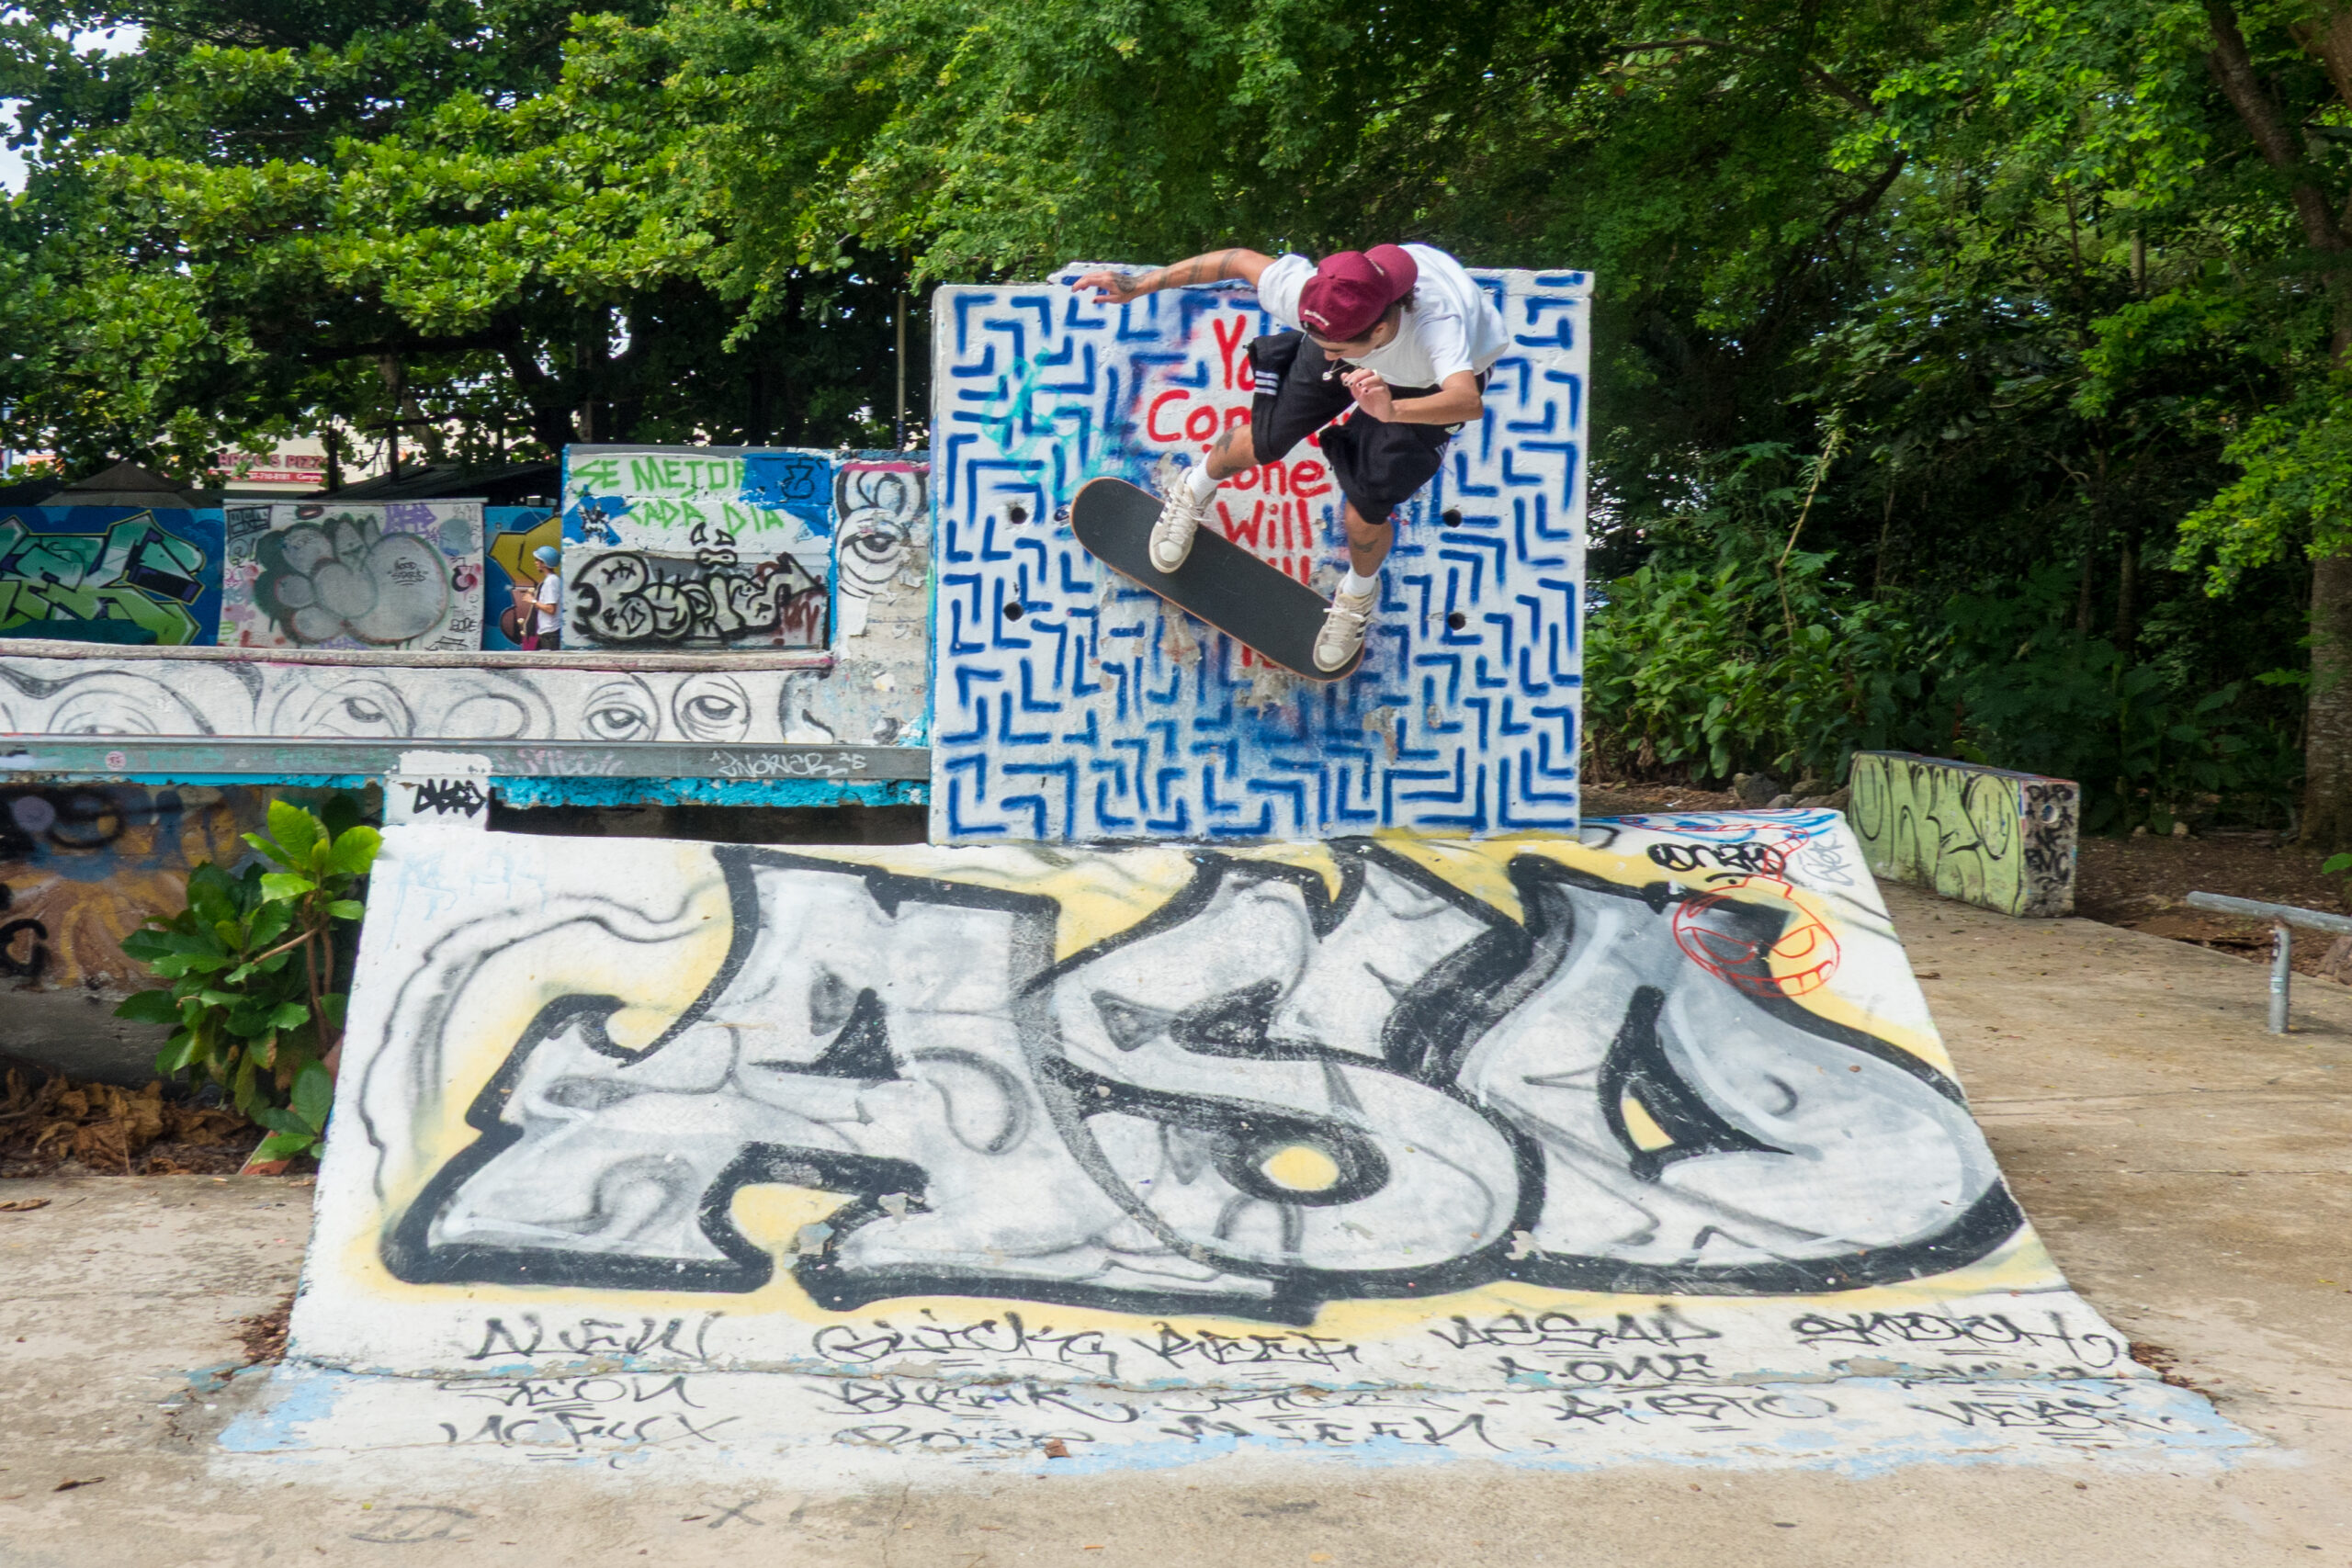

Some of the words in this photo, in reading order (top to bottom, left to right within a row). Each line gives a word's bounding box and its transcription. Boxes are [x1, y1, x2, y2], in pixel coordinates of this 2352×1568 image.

[286, 455, 328, 468] PIZZ
[1202, 444, 1332, 497] one
[627, 497, 707, 528] CADA
[722, 502, 785, 536] DIA
[1216, 498, 1312, 549] Will
